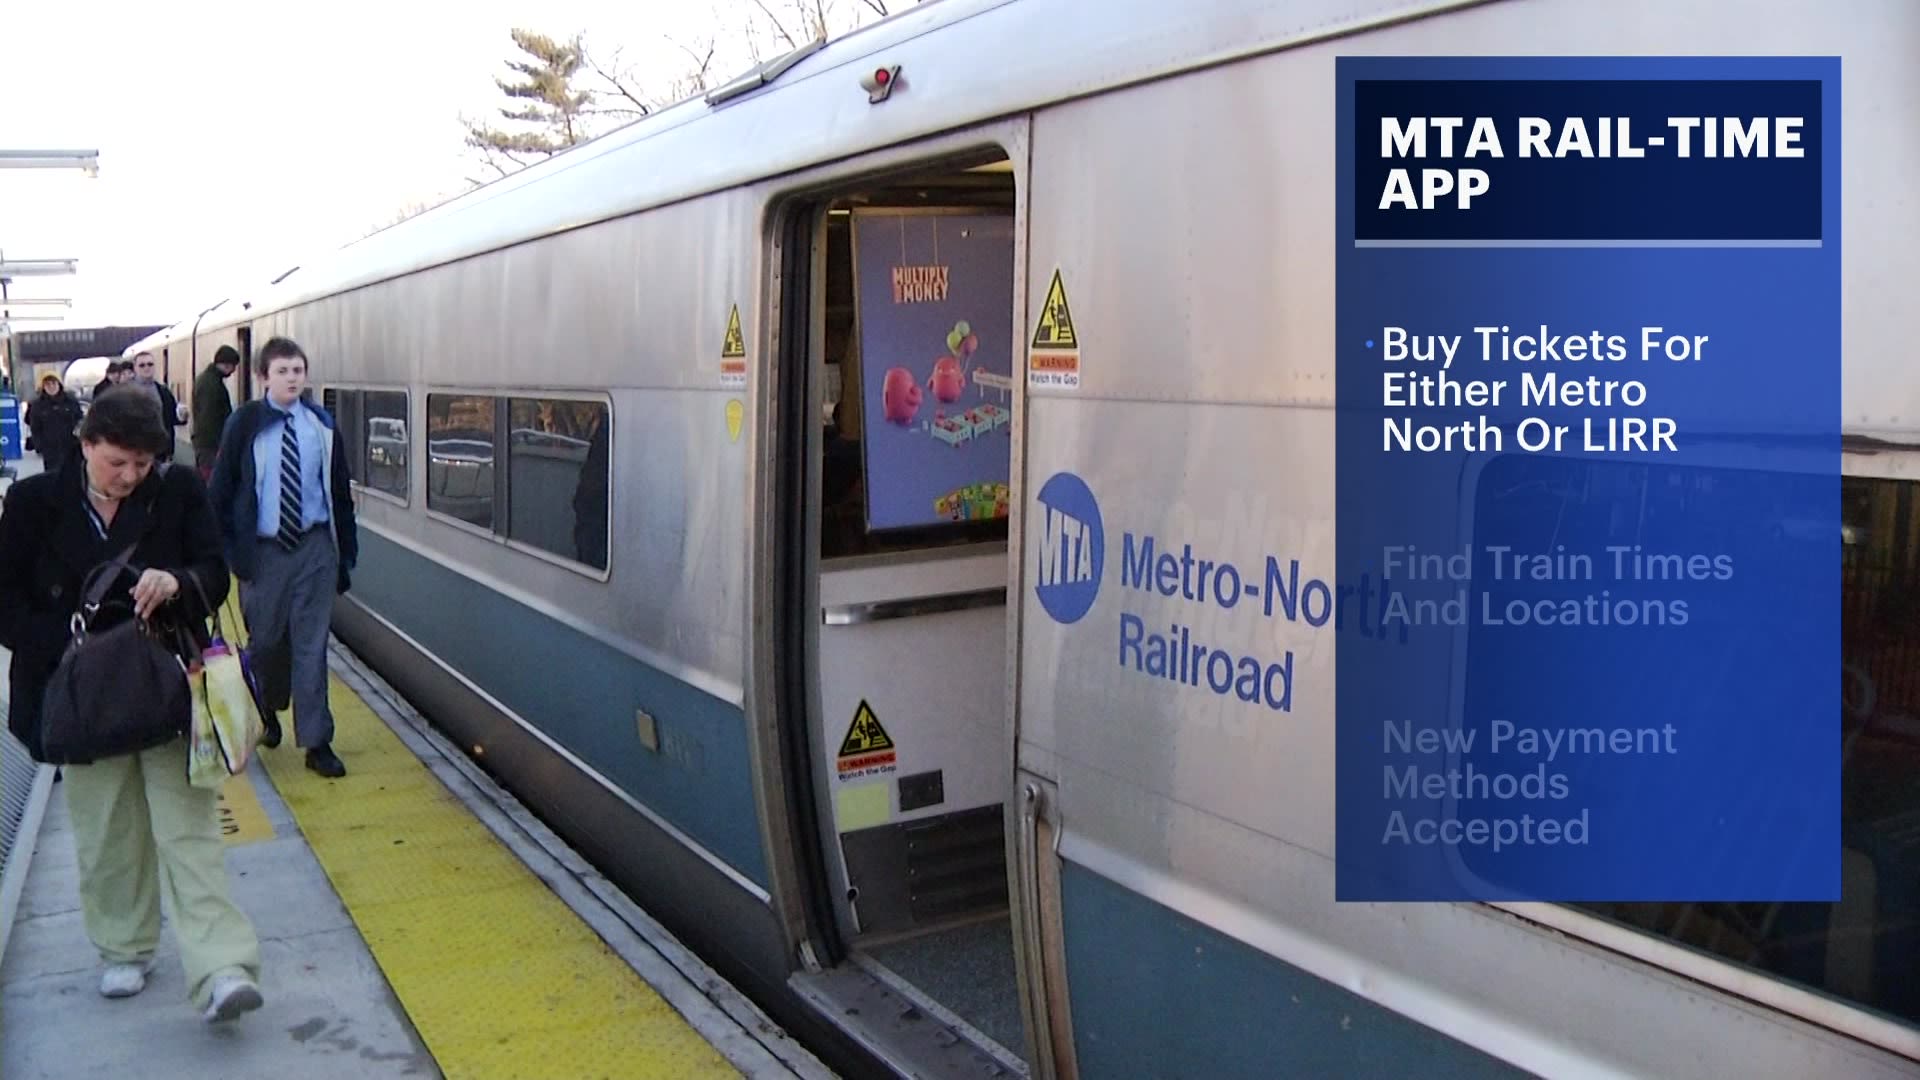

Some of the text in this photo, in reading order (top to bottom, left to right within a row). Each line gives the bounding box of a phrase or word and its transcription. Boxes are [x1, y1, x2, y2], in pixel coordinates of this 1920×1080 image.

[893, 266, 949, 285] MULTIPLY
[903, 282, 949, 304] MONEY
[1037, 498, 1093, 588] MTA
[1119, 612, 1294, 712] Railroad
